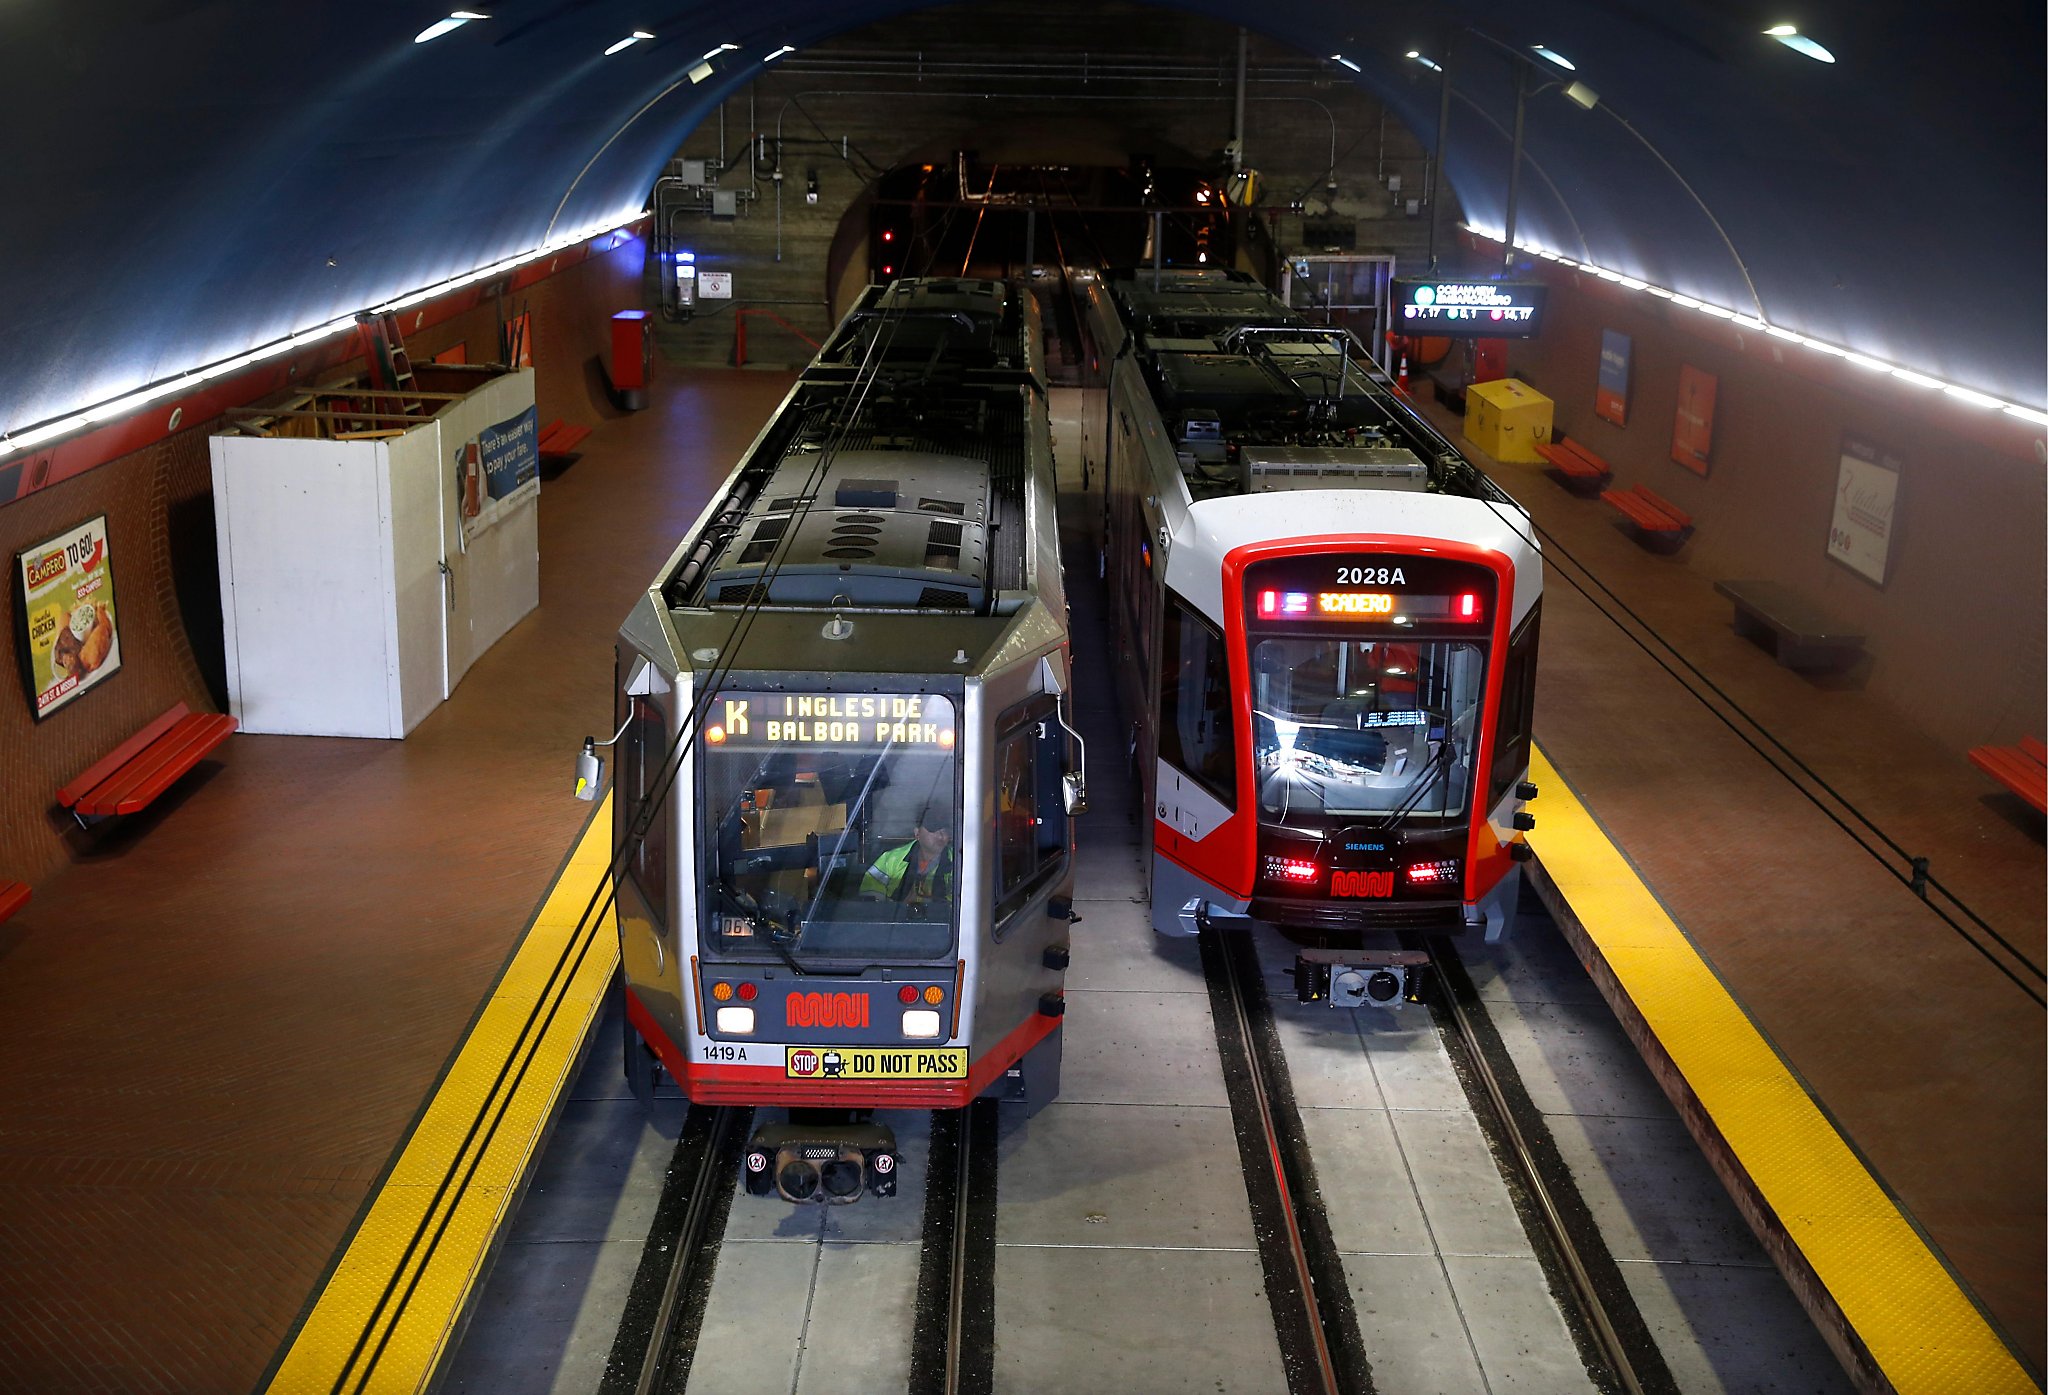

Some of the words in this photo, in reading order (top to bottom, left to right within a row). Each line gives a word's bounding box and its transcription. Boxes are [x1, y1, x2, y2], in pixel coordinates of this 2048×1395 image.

[481, 433, 500, 457] There's
[508, 424, 523, 442] easier
[523, 418, 534, 435] way
[493, 456, 503, 475] pay
[503, 448, 516, 470] your
[29, 555, 65, 584] CAMPERO
[66, 542, 79, 567] TO
[79, 532, 94, 559] GO!
[1336, 567, 1406, 585] 2028A
[31, 616, 56, 640] CHICKEN
[724, 700, 749, 735] K
[786, 696, 923, 718] INGLESIDE
[766, 720, 860, 742] BALBOA
[875, 722, 938, 743] PARK
[1344, 842, 1385, 851] SIEMENS
[702, 1045, 735, 1060] 1419
[737, 1047, 747, 1061] A
[793, 1056, 818, 1073] STOP
[853, 1054, 878, 1073] DO
[880, 1054, 913, 1073] NOT
[916, 1054, 959, 1074] PASS
